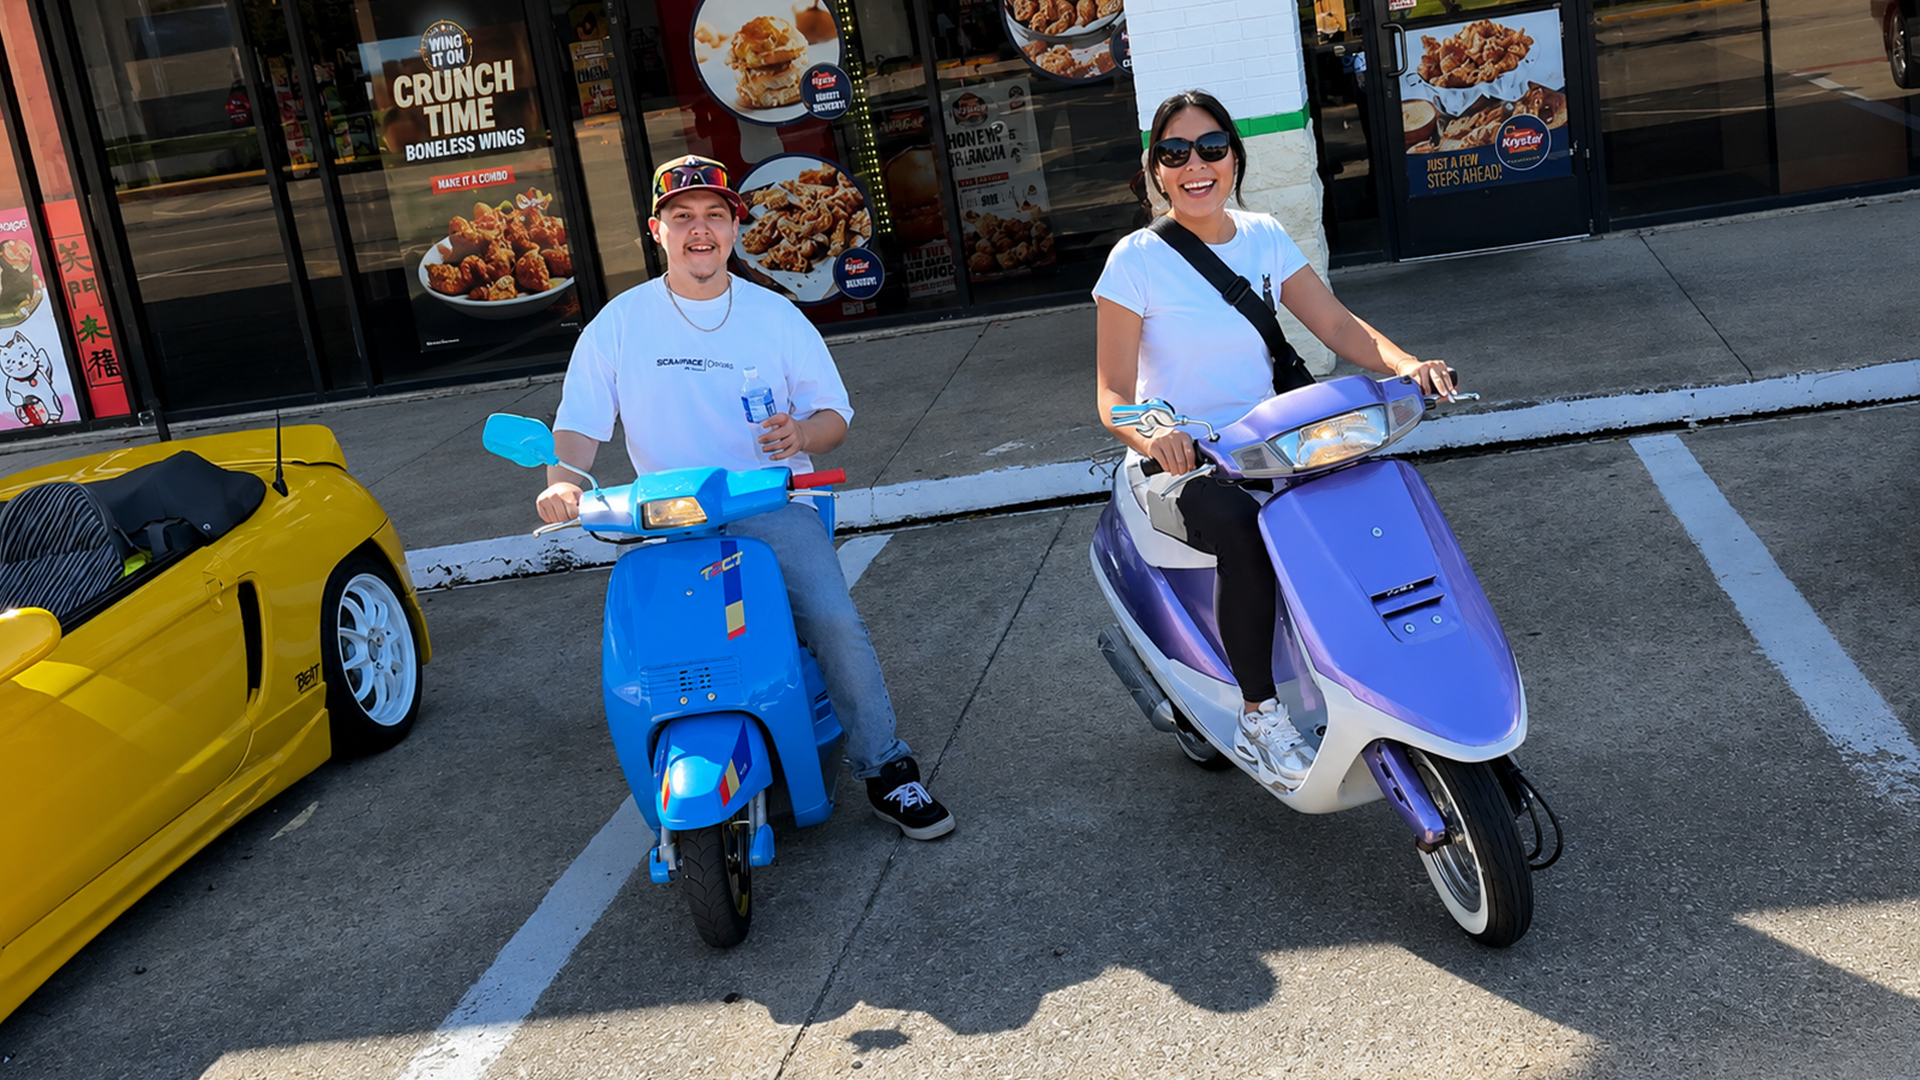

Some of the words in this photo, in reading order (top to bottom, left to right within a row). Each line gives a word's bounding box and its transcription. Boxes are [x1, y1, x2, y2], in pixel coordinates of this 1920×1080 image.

[428, 34, 463, 52] WING
[431, 52, 444, 67] IT
[446, 48, 466, 65] ON
[393, 59, 516, 109] CRUNCH
[423, 96, 496, 137] TIME
[405, 135, 475, 162] BONELESS
[478, 127, 526, 151] WINGS
[1427, 157, 1448, 172] JUST
[1450, 156, 1458, 169] A
[1459, 153, 1479, 168] FEW
[437, 176, 461, 190] MAKE
[462, 174, 471, 186] IT
[471, 174, 478, 184] A
[478, 170, 508, 184] COMBO
[1426, 169, 1460, 189] STEPS
[1462, 163, 1503, 185] AHEAD!
